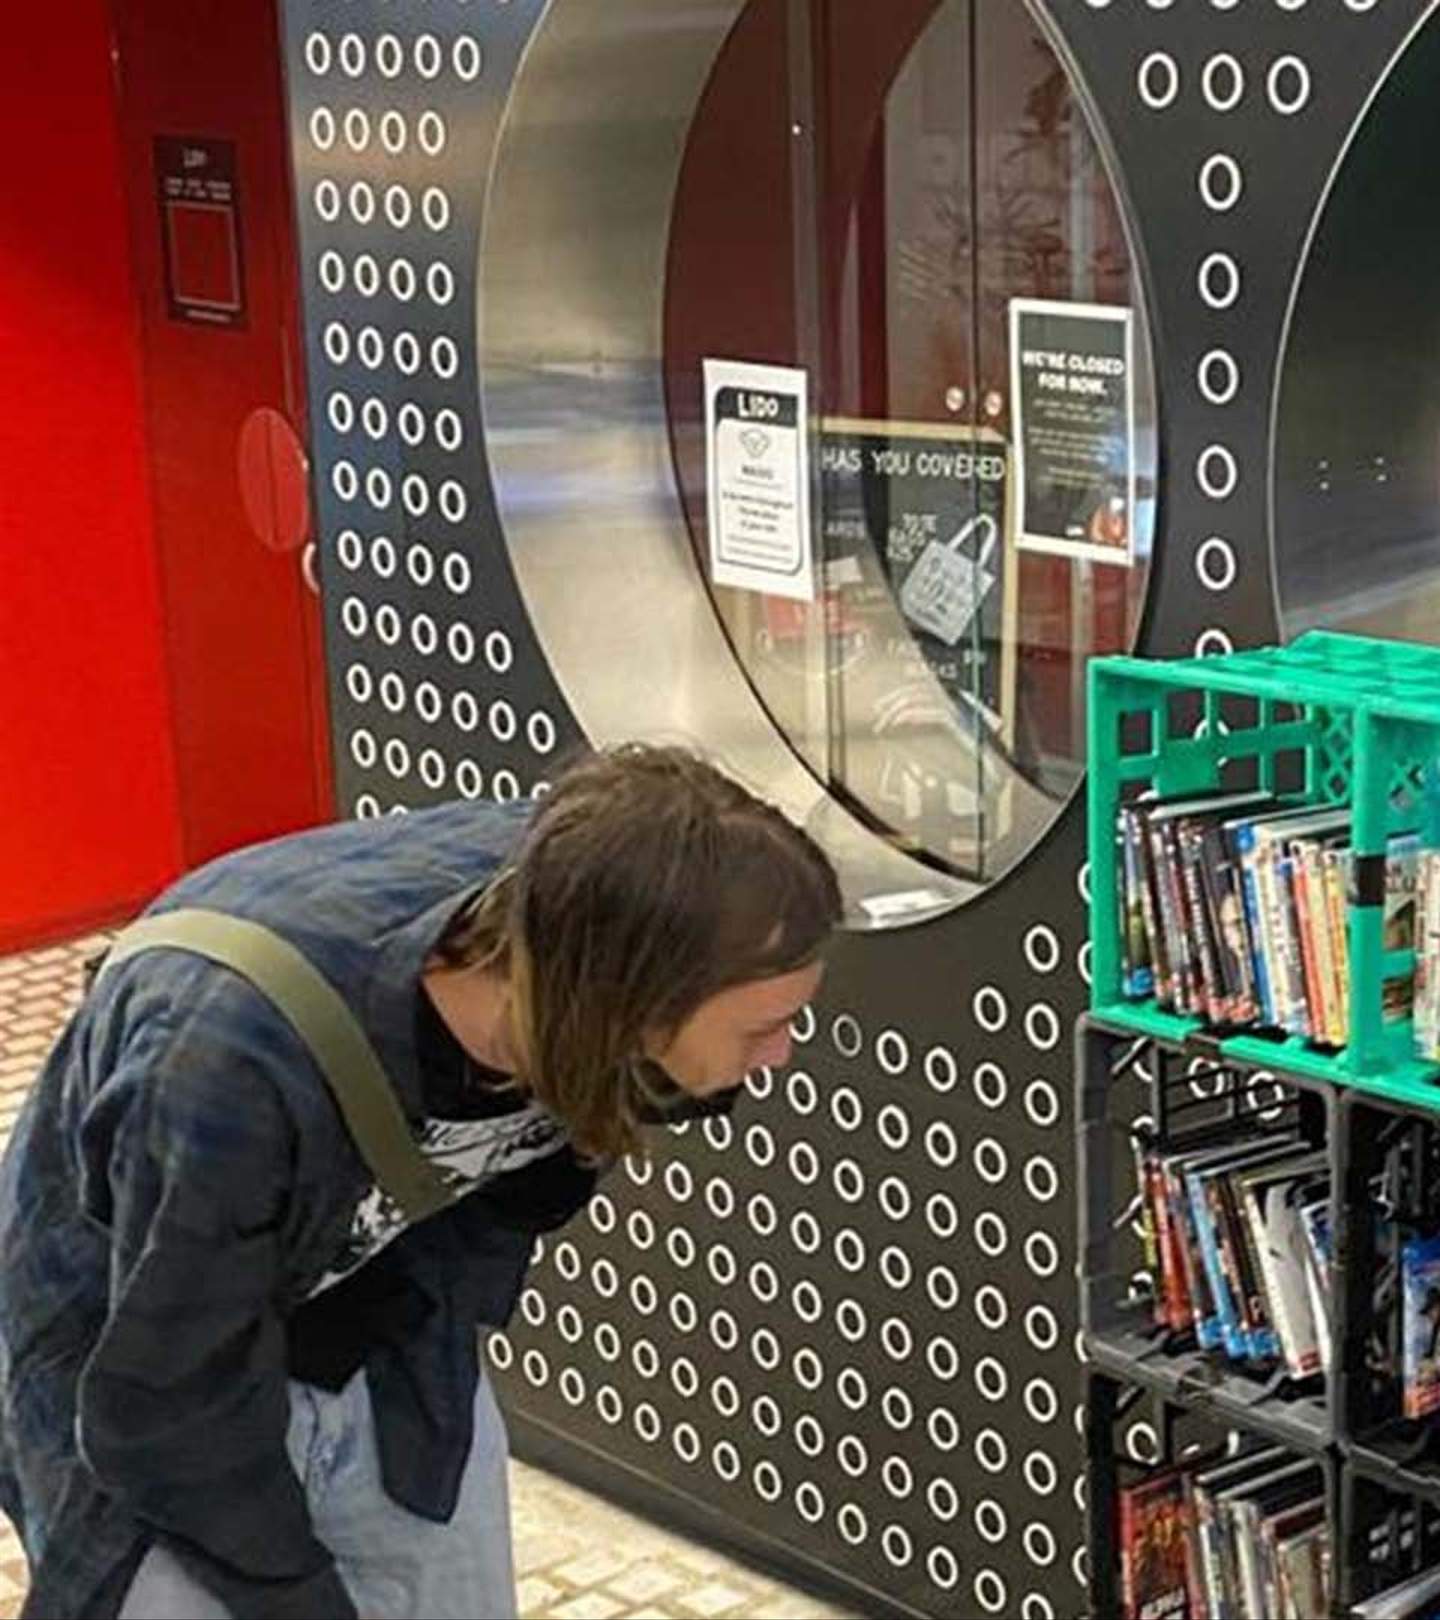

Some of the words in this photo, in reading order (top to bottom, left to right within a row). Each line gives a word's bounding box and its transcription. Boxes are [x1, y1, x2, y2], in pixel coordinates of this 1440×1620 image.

[1068, 356, 1125, 376] CLOSED
[1038, 372, 1066, 390] FOR
[737, 392, 779, 418] LIDO
[822, 448, 862, 473] HAS
[871, 450, 910, 476] YOU
